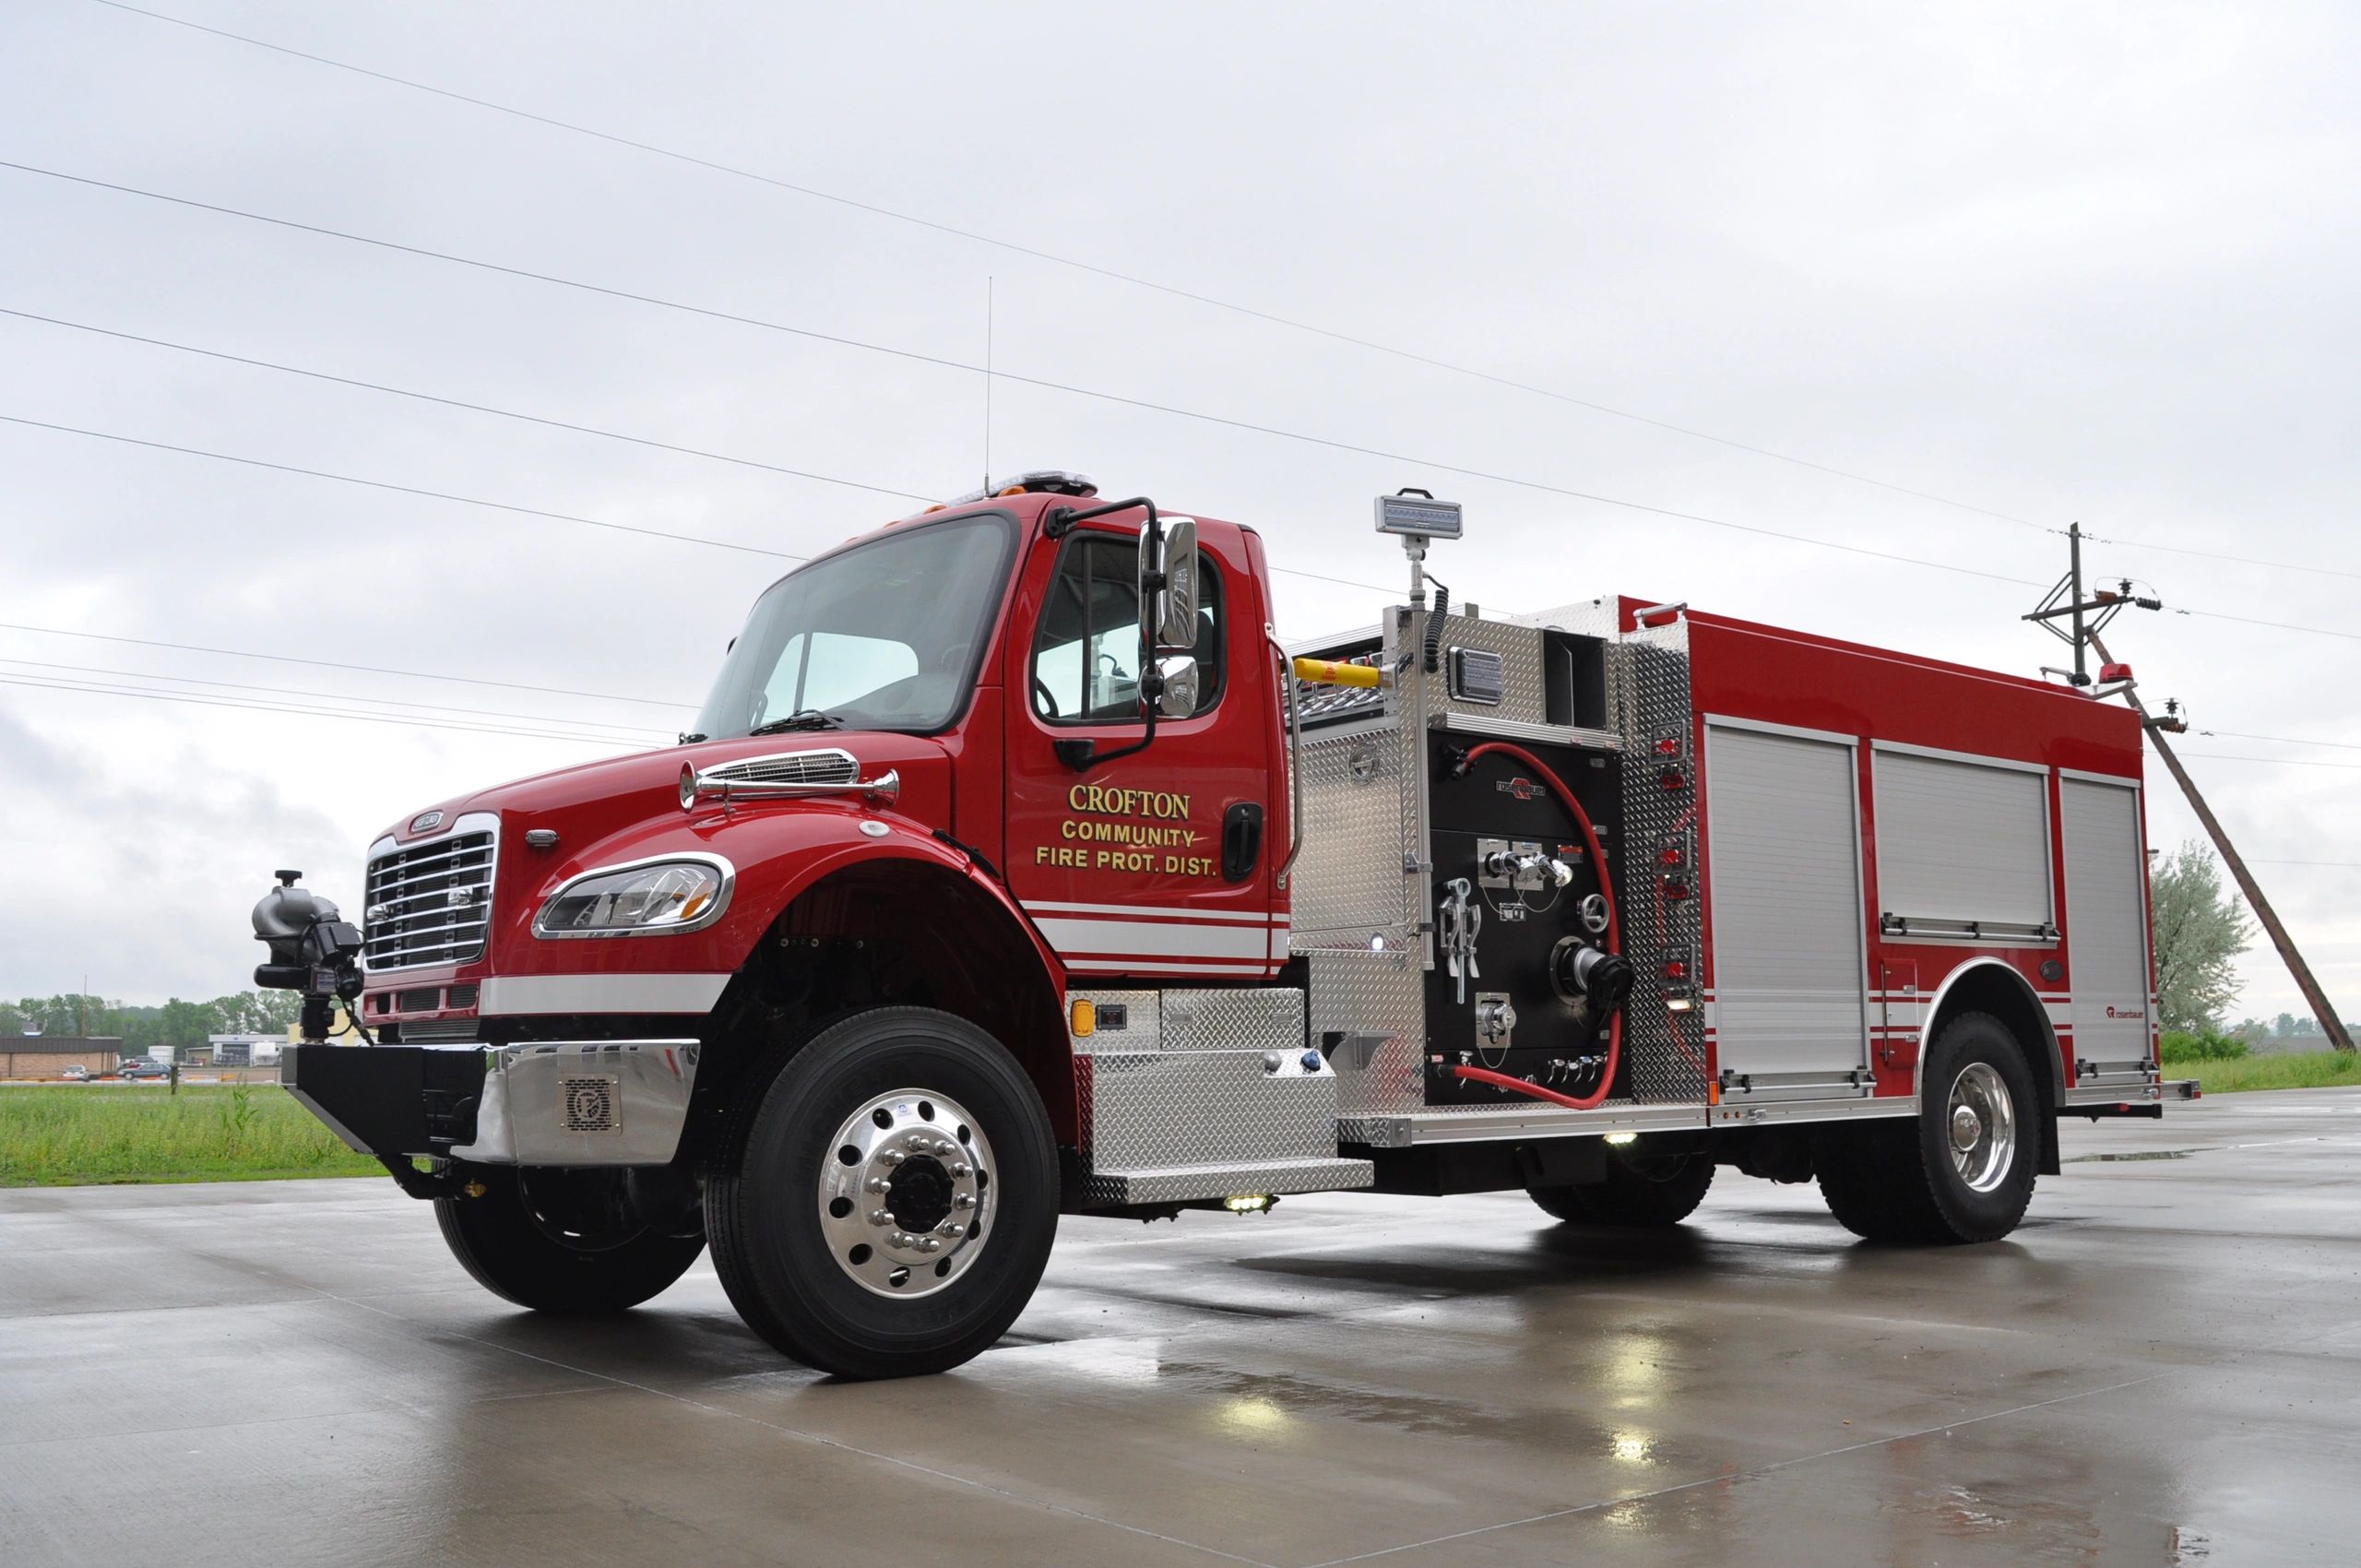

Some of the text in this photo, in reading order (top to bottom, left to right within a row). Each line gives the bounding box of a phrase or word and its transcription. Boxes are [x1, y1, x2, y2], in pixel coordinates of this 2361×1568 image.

[1069, 784, 1191, 820] CROFTON
[1062, 820, 1195, 848] COMMUNITY
[1036, 846, 1217, 877] FIRE PROT. DIST.
